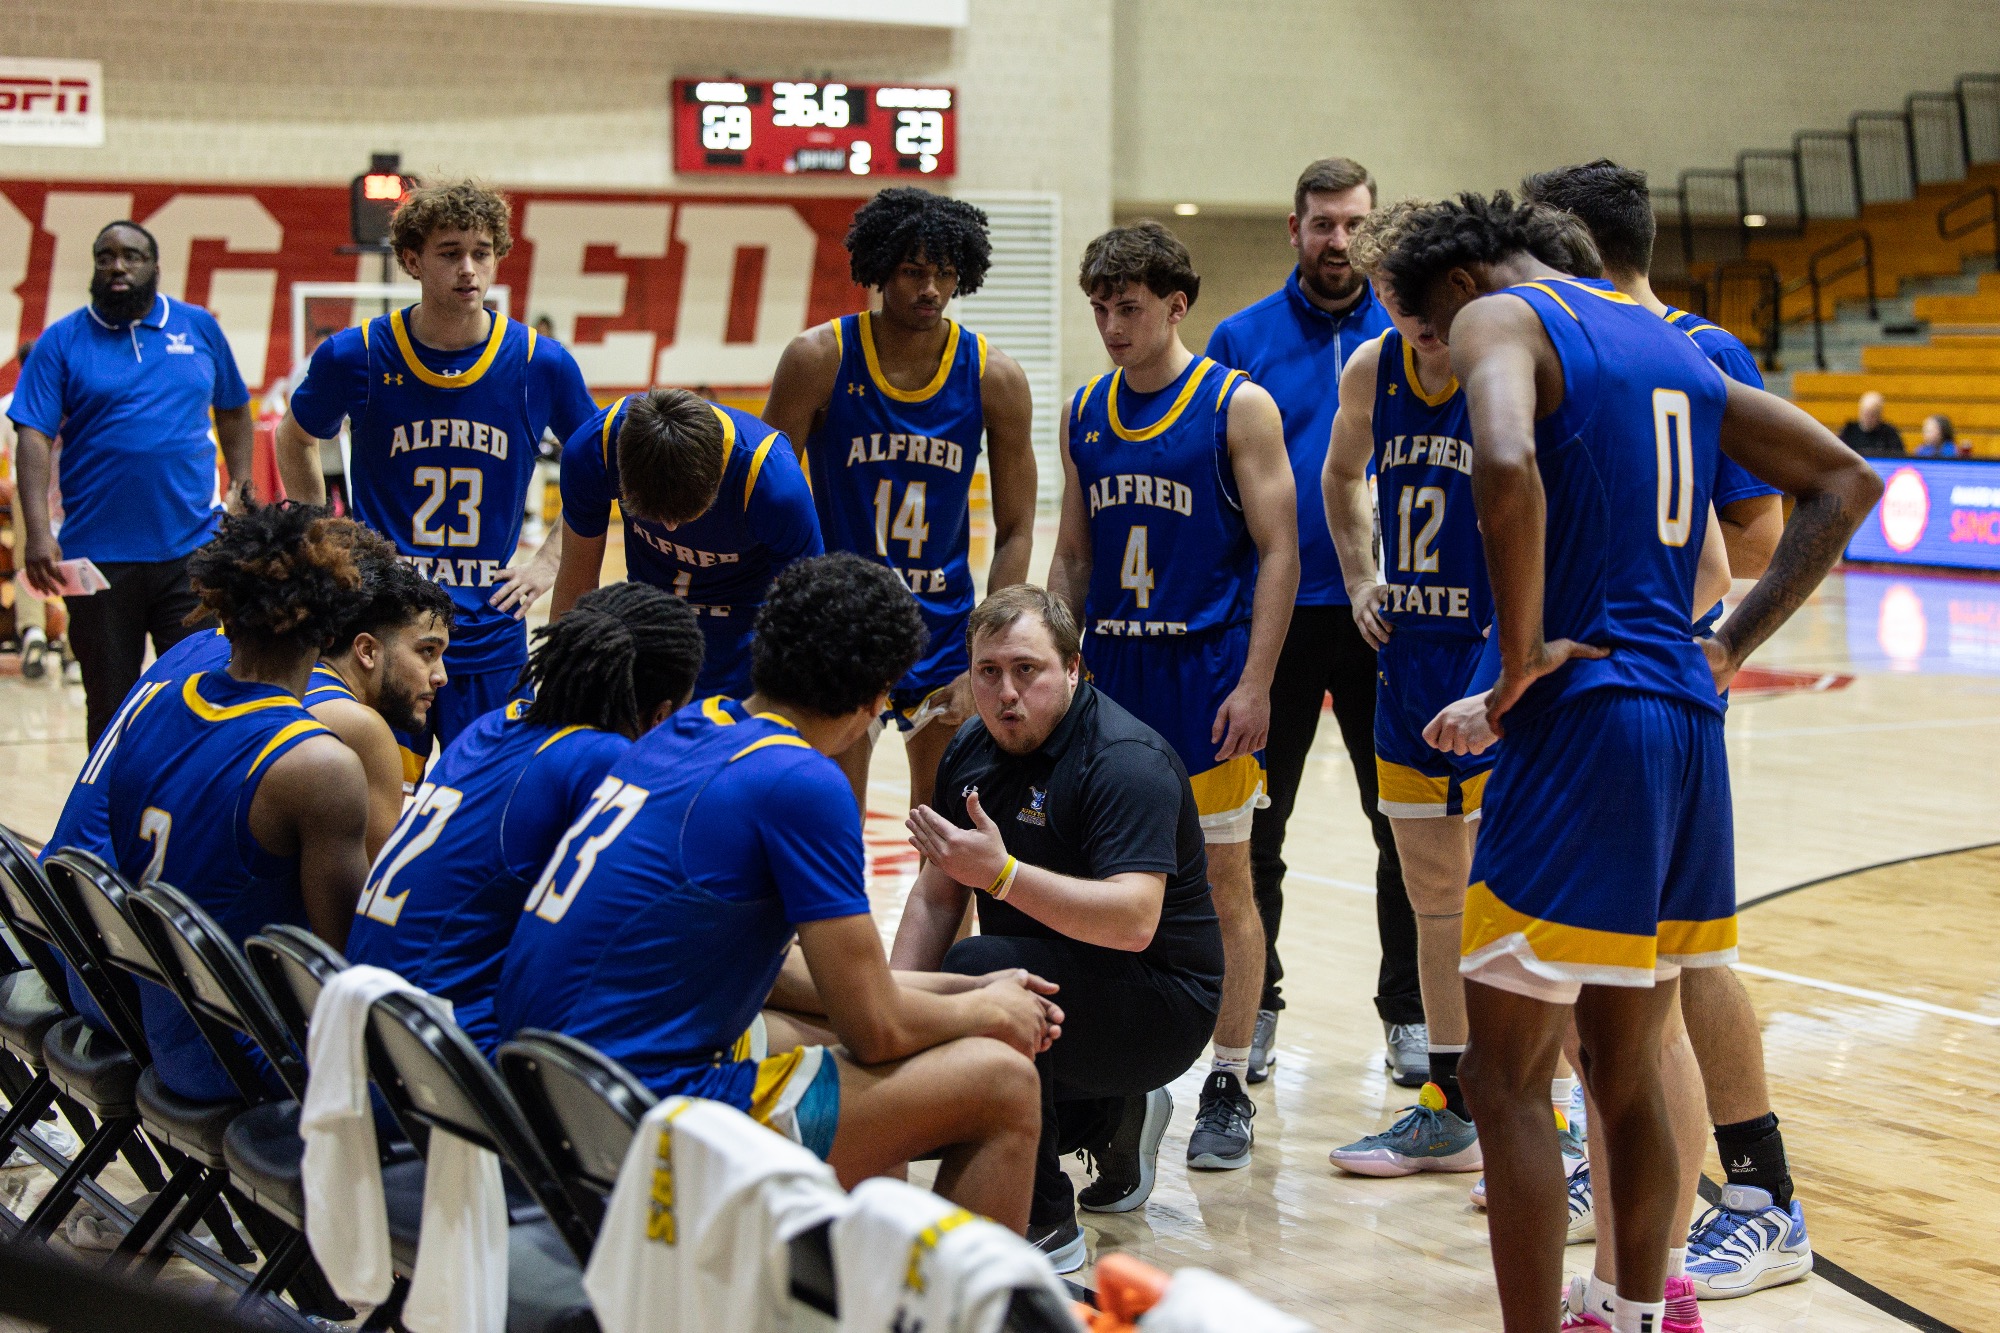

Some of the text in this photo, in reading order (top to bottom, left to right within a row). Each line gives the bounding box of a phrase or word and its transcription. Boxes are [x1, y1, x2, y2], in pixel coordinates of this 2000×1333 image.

[0, 78, 89, 112] SPN
[895, 110, 944, 155] 23
[0, 190, 284, 390] IG
[390, 418, 509, 461] ALFRED
[846, 433, 964, 474] ALFRED
[1379, 435, 1474, 476] ALFRED
[1652, 388, 1694, 547] 0
[412, 466, 484, 547] 23
[873, 478, 930, 559] 14
[1089, 474, 1193, 519] ALFRED
[632, 521, 740, 568] ALFRED
[1397, 485, 1446, 573] 12
[396, 555, 500, 588] TATE
[1120, 525, 1155, 609] 4
[1383, 583, 1471, 619] TATE
[355, 782, 464, 927] 22
